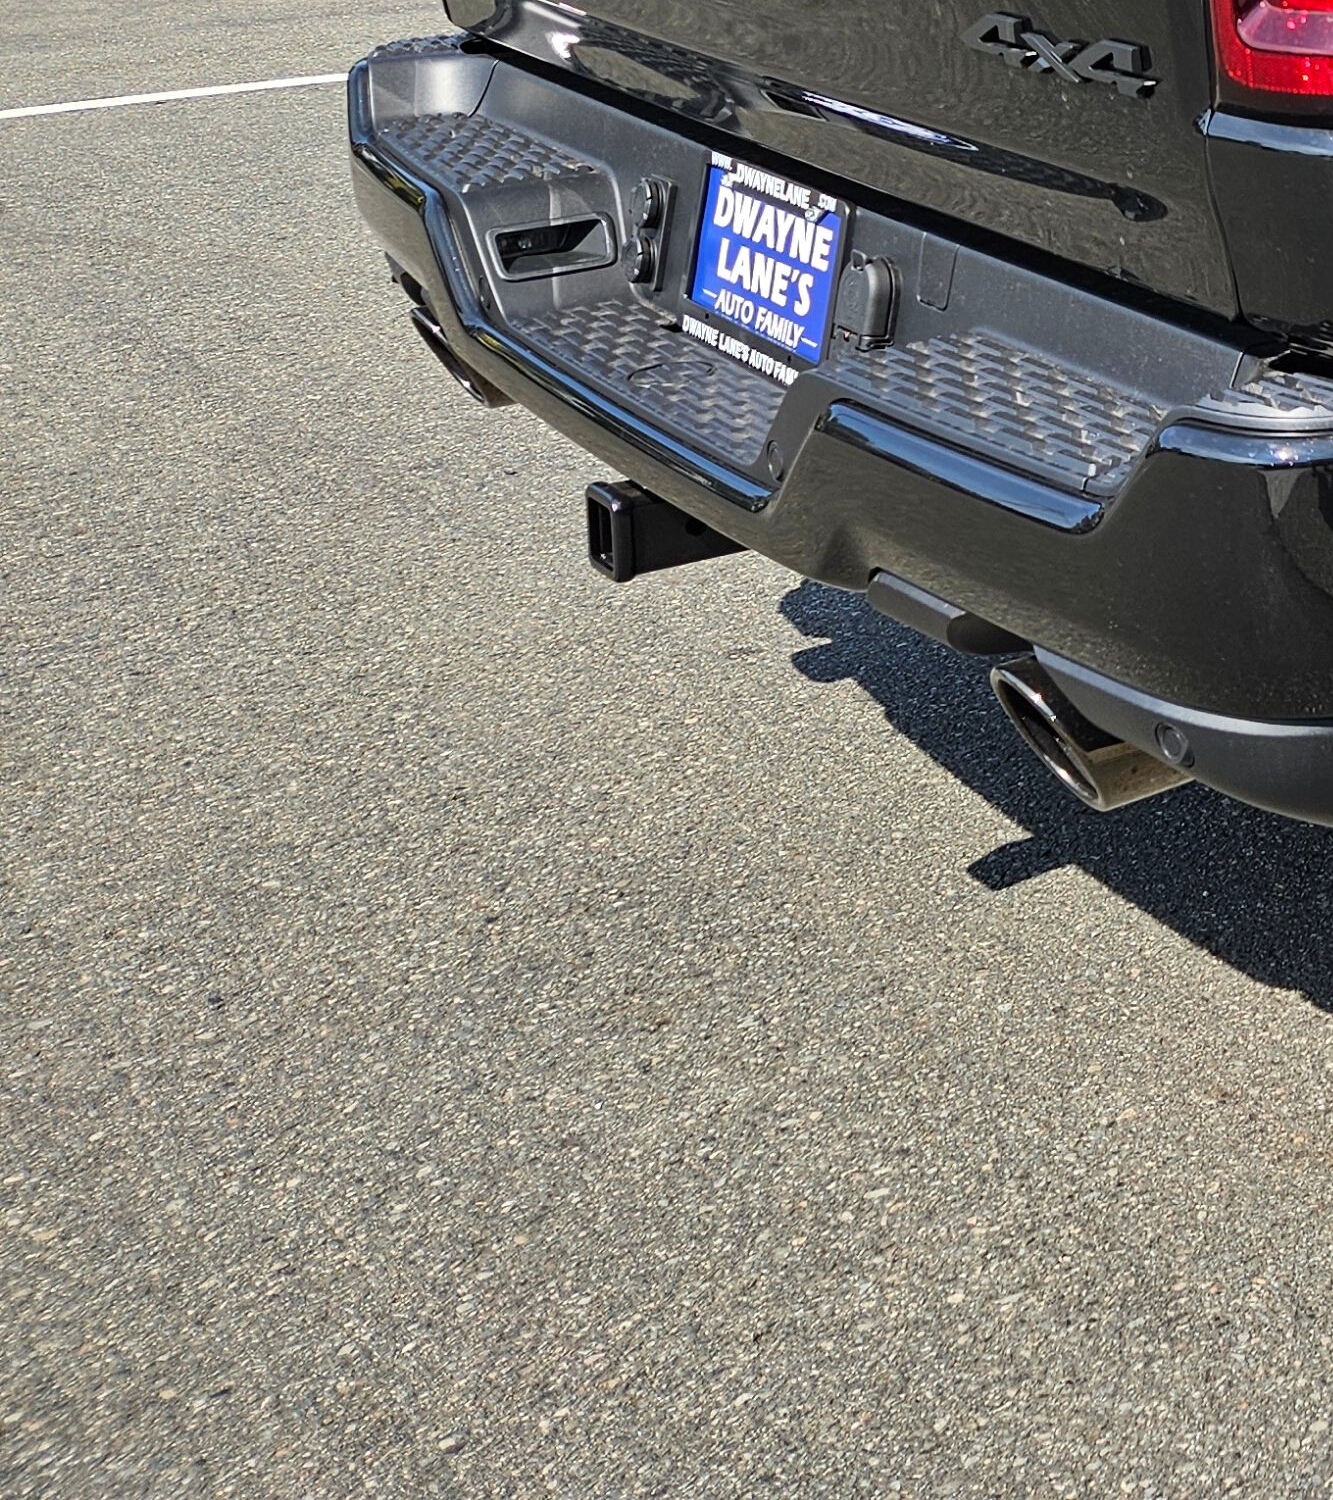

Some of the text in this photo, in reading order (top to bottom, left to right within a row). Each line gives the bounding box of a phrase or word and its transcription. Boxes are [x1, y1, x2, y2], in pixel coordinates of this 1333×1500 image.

[713, 187, 834, 272] DWAYNE
[716, 237, 814, 317] LANE'S
[681, 314, 719, 347] DWAYNE
[718, 332, 751, 361] LANE'S
[748, 350, 773, 376] AUTO
[714, 289, 754, 325] AUTO
[755, 309, 805, 349] FAMILY
